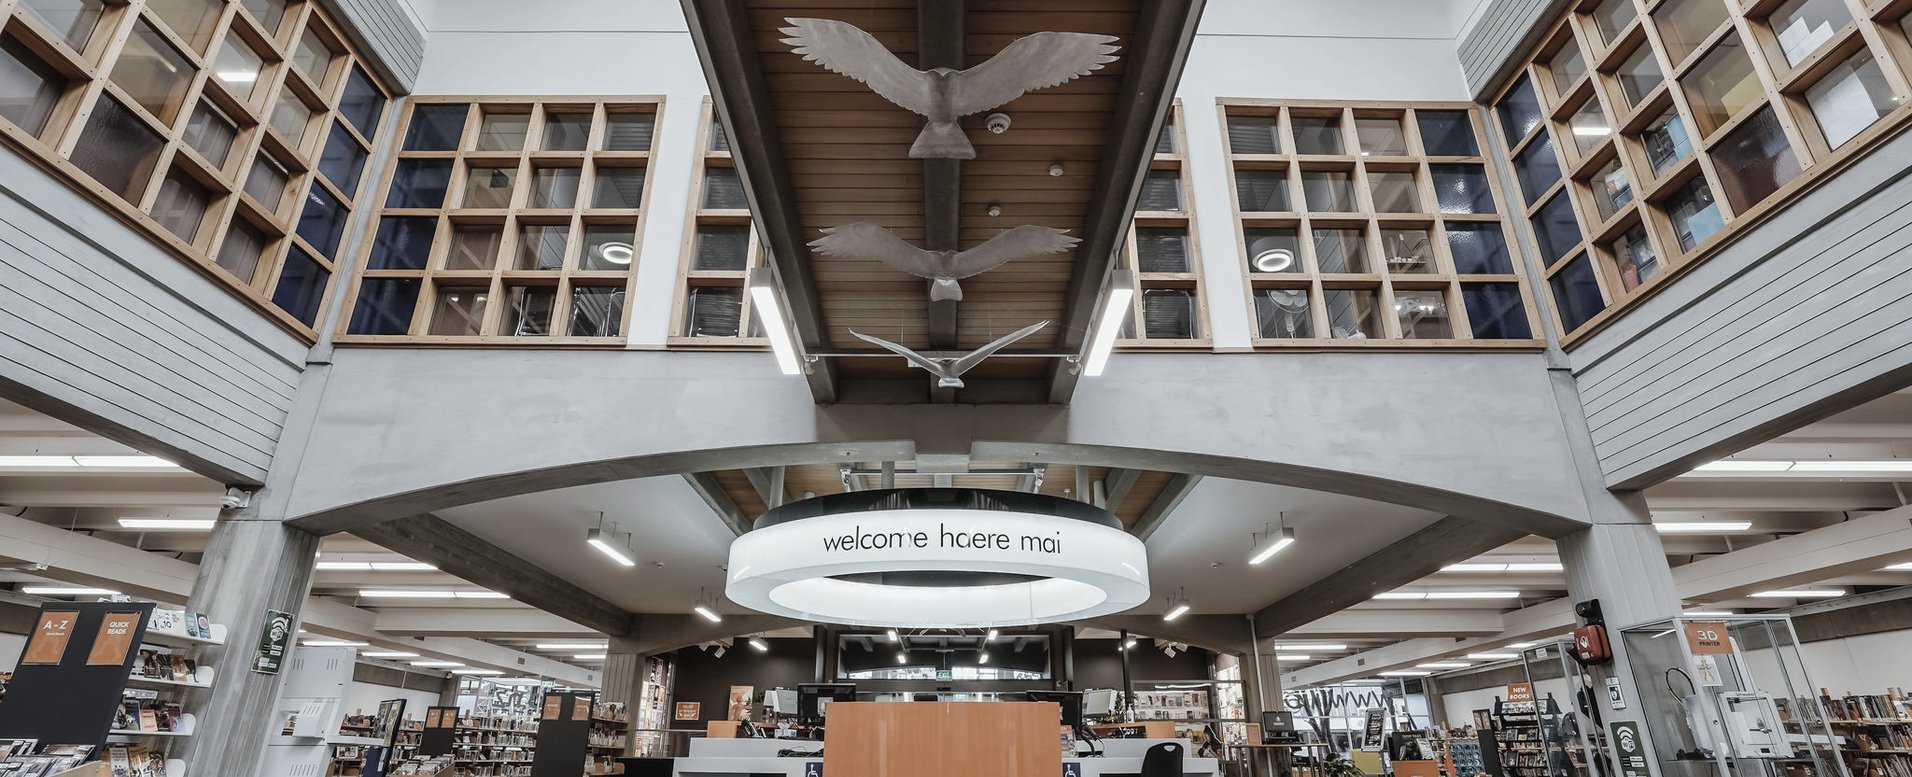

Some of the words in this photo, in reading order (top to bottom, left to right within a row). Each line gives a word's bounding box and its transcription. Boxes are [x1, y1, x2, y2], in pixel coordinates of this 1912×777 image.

[823, 525, 928, 552] welcome
[940, 523, 1010, 549] haere
[1021, 531, 1061, 554] mai
[1697, 630, 1718, 640] 3D
